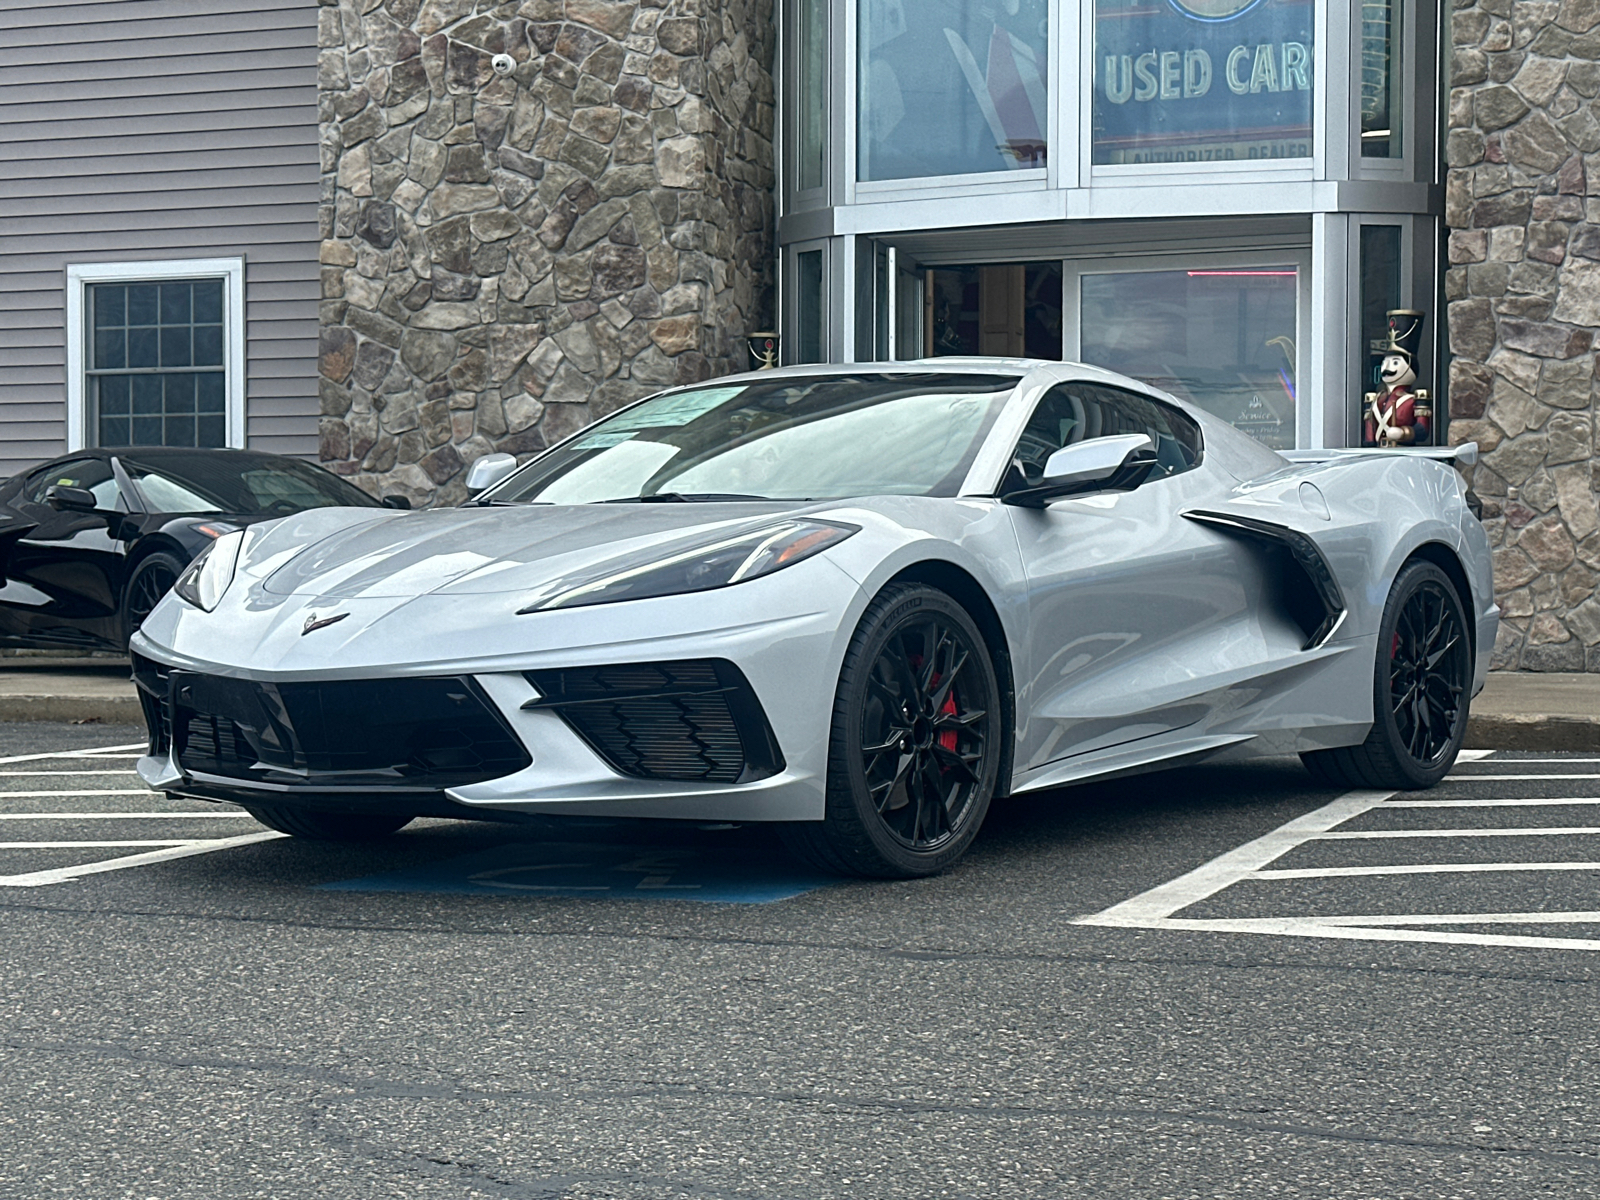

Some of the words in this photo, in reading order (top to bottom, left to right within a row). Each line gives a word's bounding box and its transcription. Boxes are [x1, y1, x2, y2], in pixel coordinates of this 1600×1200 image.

[1105, 49, 1212, 104] USED
[1226, 42, 1313, 95] CAR
[1248, 144, 1307, 159] DEALER
[1238, 409, 1271, 420] Service
[884, 597, 922, 629] MICHELIN
